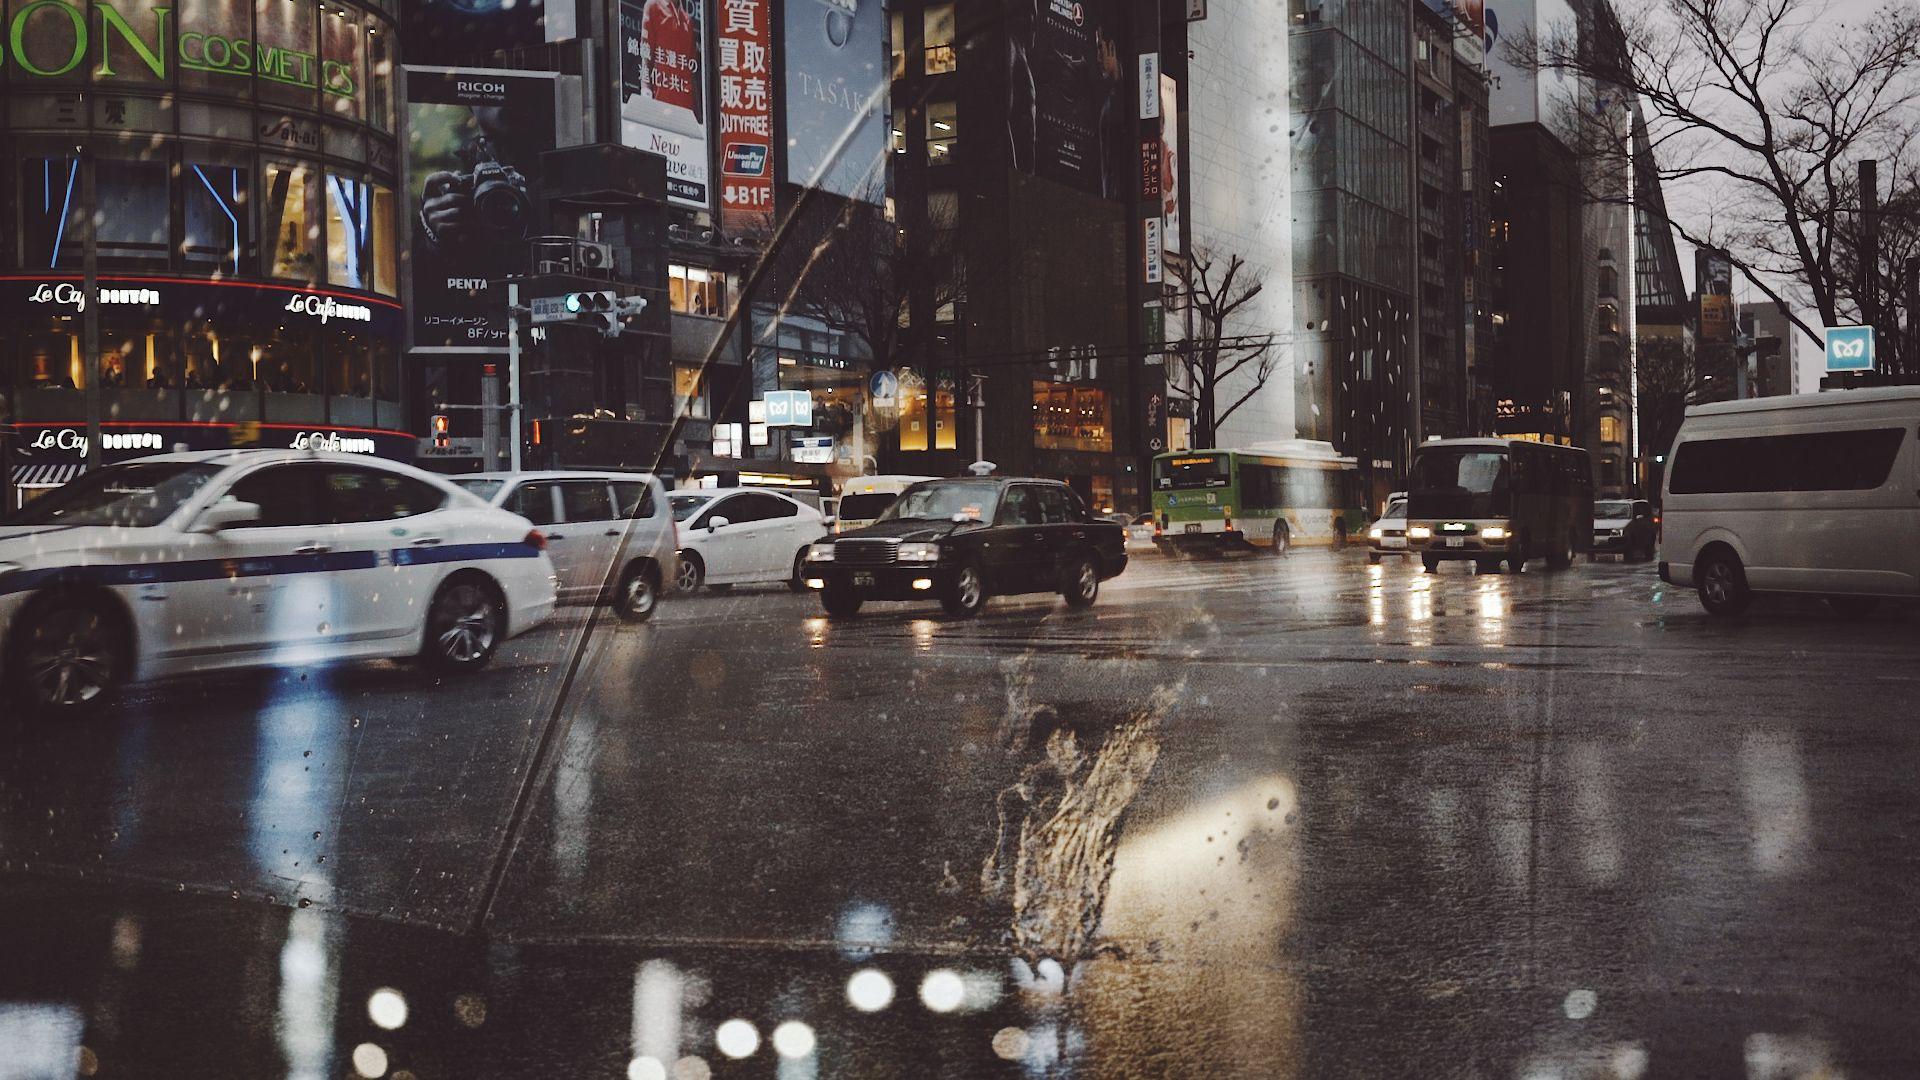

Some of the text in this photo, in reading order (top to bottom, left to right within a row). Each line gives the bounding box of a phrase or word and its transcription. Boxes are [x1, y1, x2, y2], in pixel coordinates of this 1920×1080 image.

[724, 0, 760, 36] 質
[0, 0, 354, 94] ON COSMETCS
[719, 37, 766, 73] 買取
[457, 81, 505, 93] RICOH
[637, 64, 691, 94] 進化と共に
[720, 76, 767, 112] 販売
[798, 71, 873, 118] TASAKI
[719, 112, 769, 137] DUTYFREE
[650, 133, 680, 157] New
[738, 185, 771, 206] B1F
[29, 284, 53, 303] Le
[285, 294, 304, 312] Le
[31, 429, 55, 449] Le
